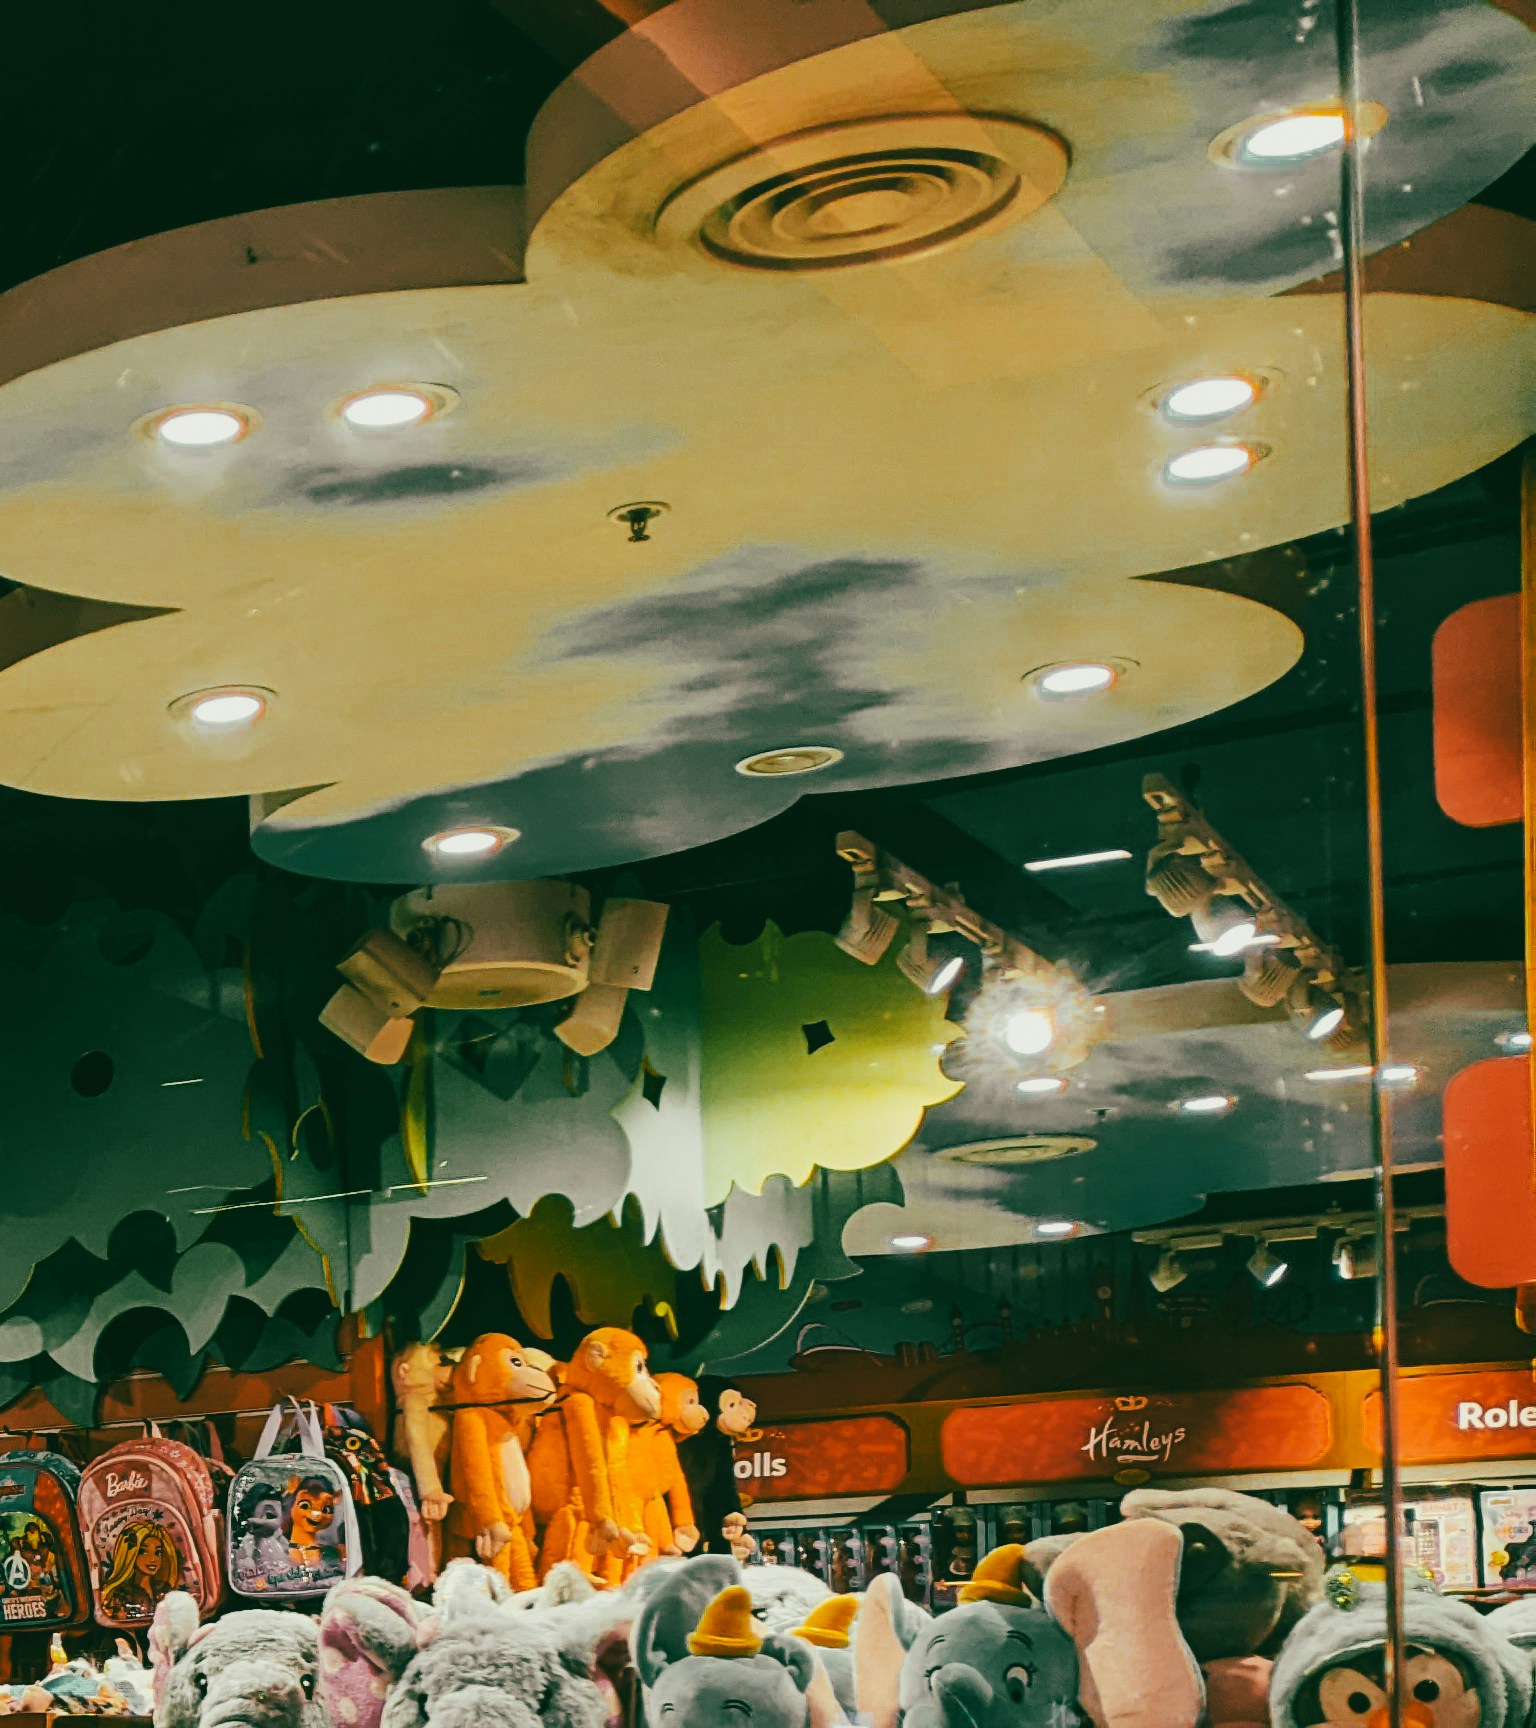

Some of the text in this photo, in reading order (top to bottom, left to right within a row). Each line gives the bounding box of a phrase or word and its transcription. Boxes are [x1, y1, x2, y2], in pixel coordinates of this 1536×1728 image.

[1458, 1399, 1536, 1430] Role
[1081, 1416, 1188, 1464] Hamleys
[732, 1449, 787, 1479] olls
[105, 1470, 149, 1498] Barbie
[3, 1601, 47, 1620] HEROES
